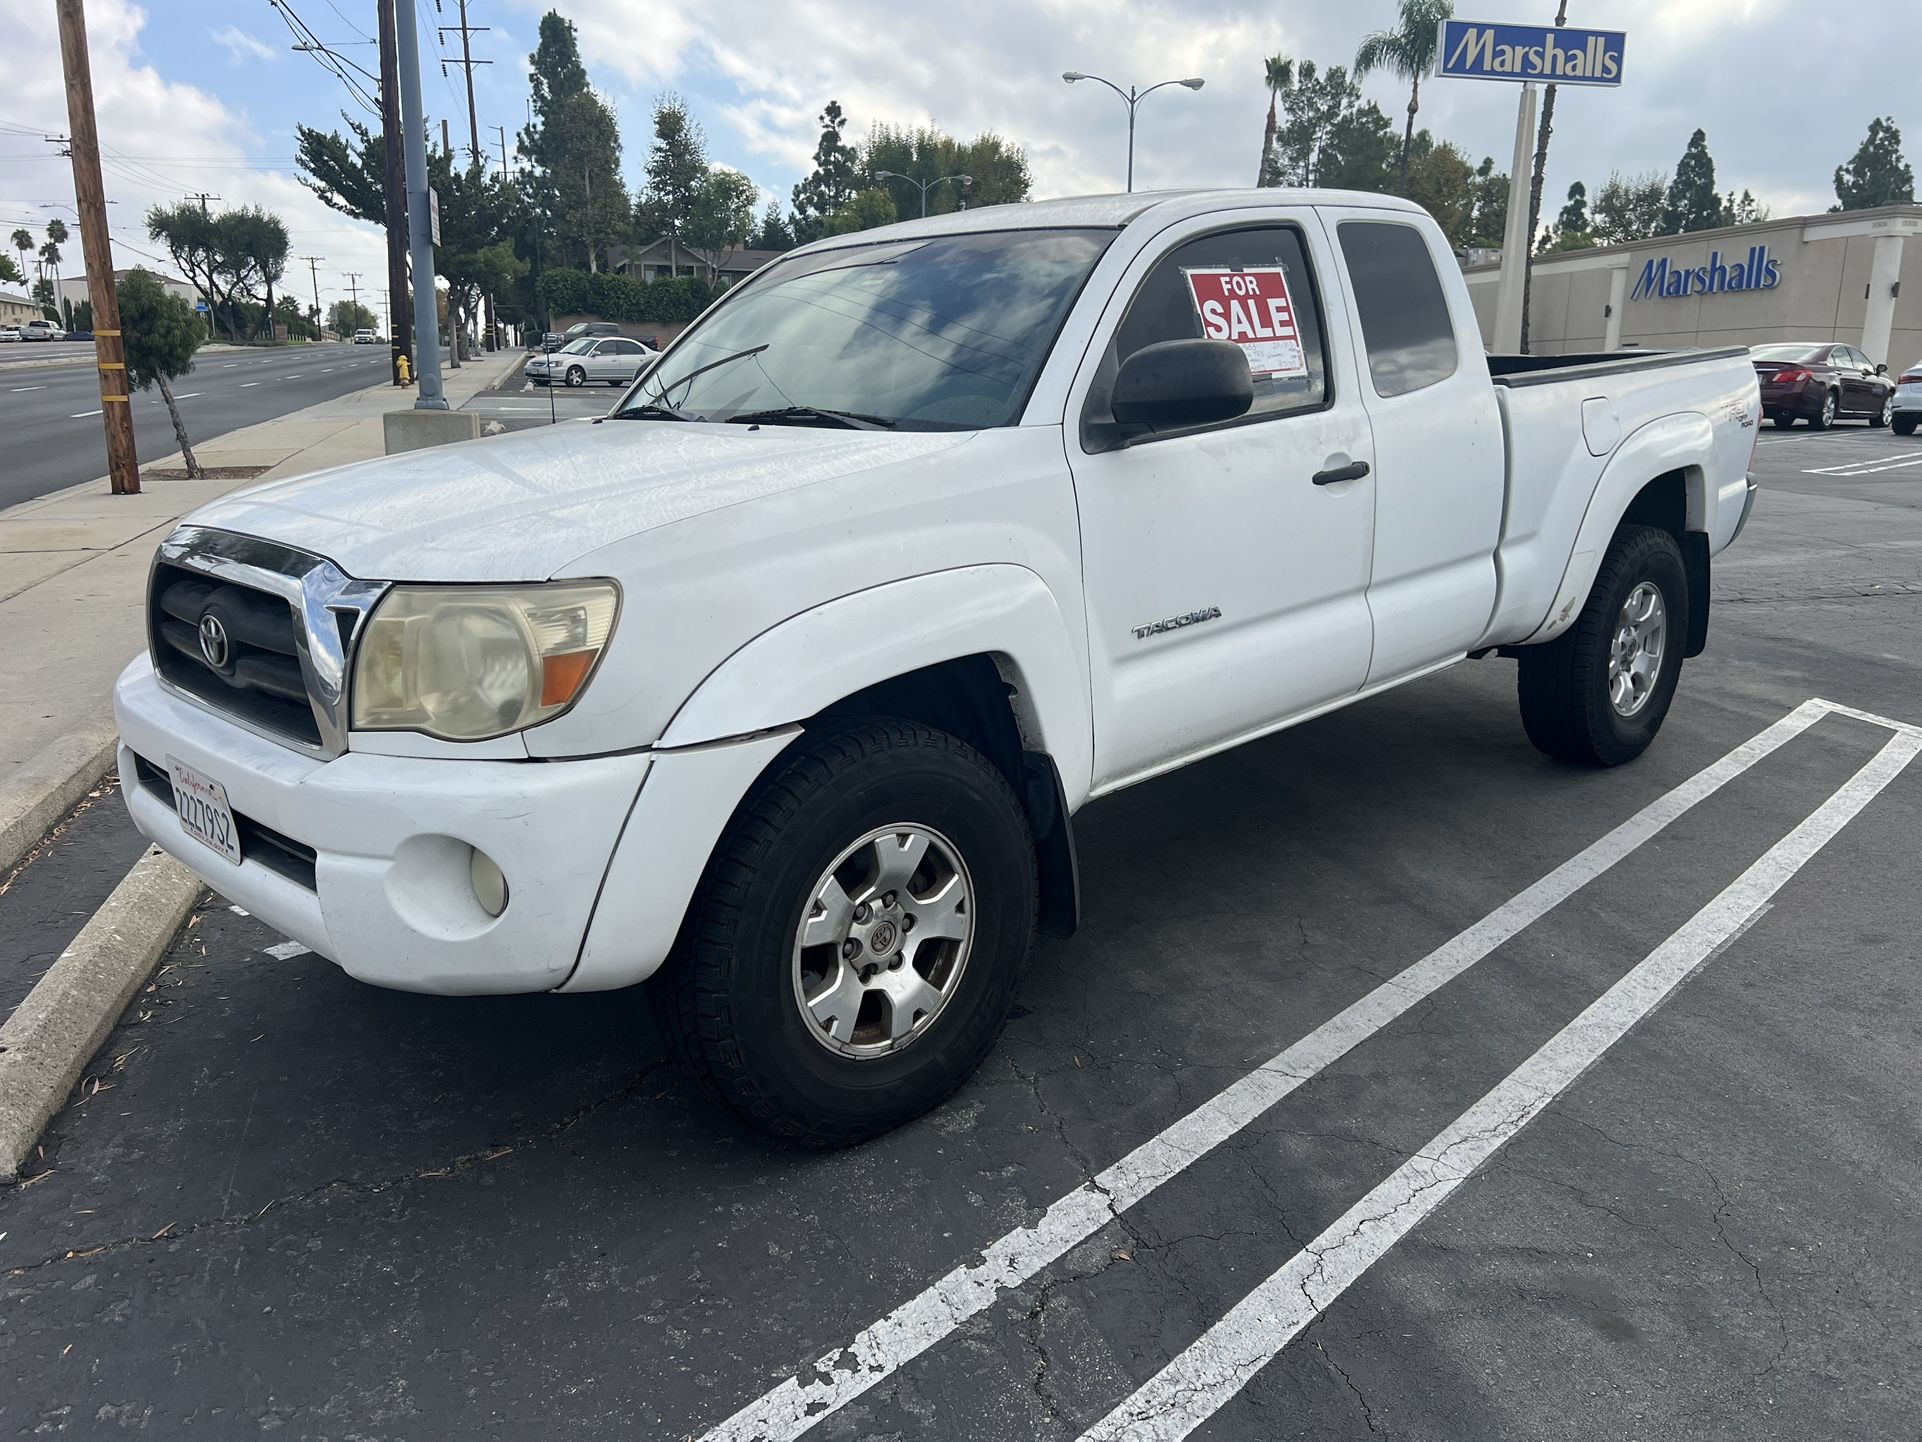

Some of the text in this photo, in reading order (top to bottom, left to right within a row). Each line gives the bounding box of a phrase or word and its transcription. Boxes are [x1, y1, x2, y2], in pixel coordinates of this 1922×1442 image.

[1446, 27, 1619, 79] Marshalls
[1219, 275, 1261, 297] FOR
[1630, 245, 1782, 301] Marshalls
[1202, 298, 1295, 341] SALE
[1131, 605, 1223, 640] TACOMA
[175, 786, 235, 851] 22279S2
